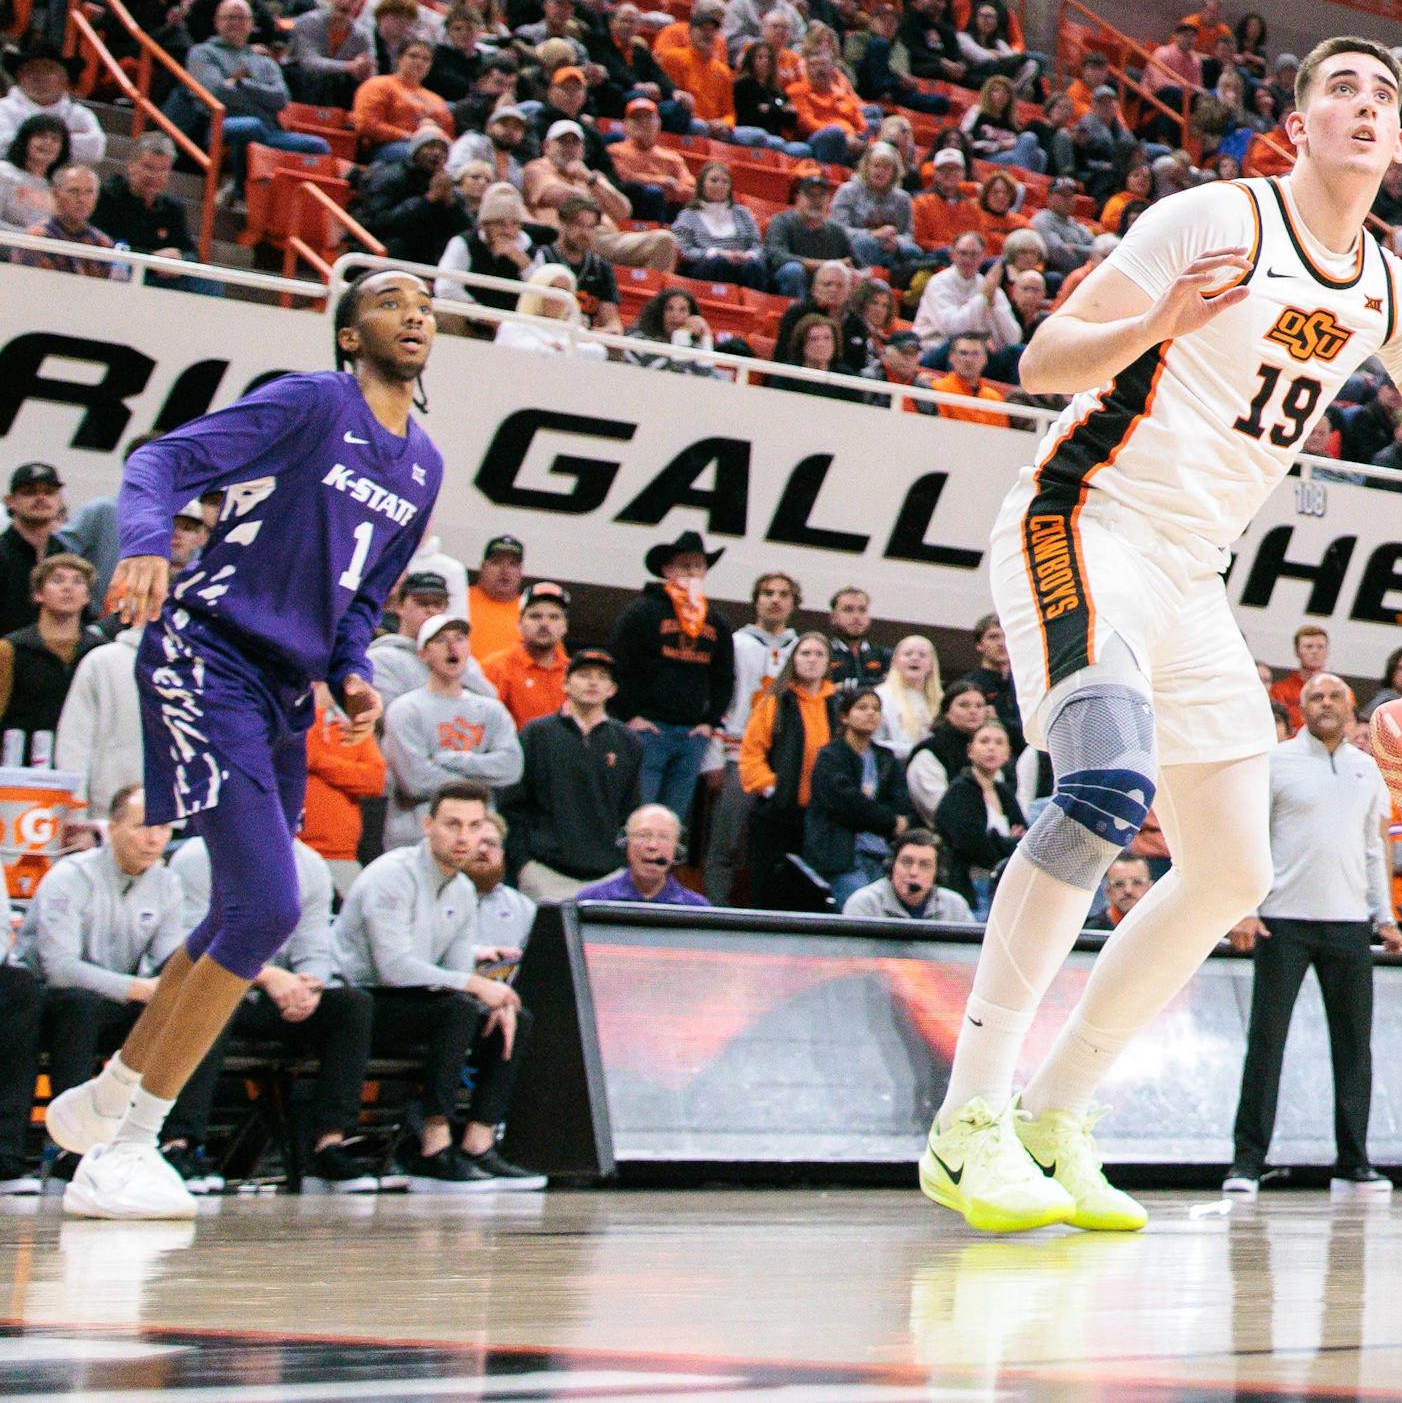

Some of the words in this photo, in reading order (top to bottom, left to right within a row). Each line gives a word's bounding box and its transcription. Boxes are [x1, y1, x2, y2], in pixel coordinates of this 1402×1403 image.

[1262, 305, 1356, 364] OSU
[1232, 362, 1322, 449] 19
[321, 463, 418, 527] K-STATE
[1294, 482, 1327, 518] 108
[339, 521, 374, 591] 1
[1029, 514, 1079, 619] COWBOYS
